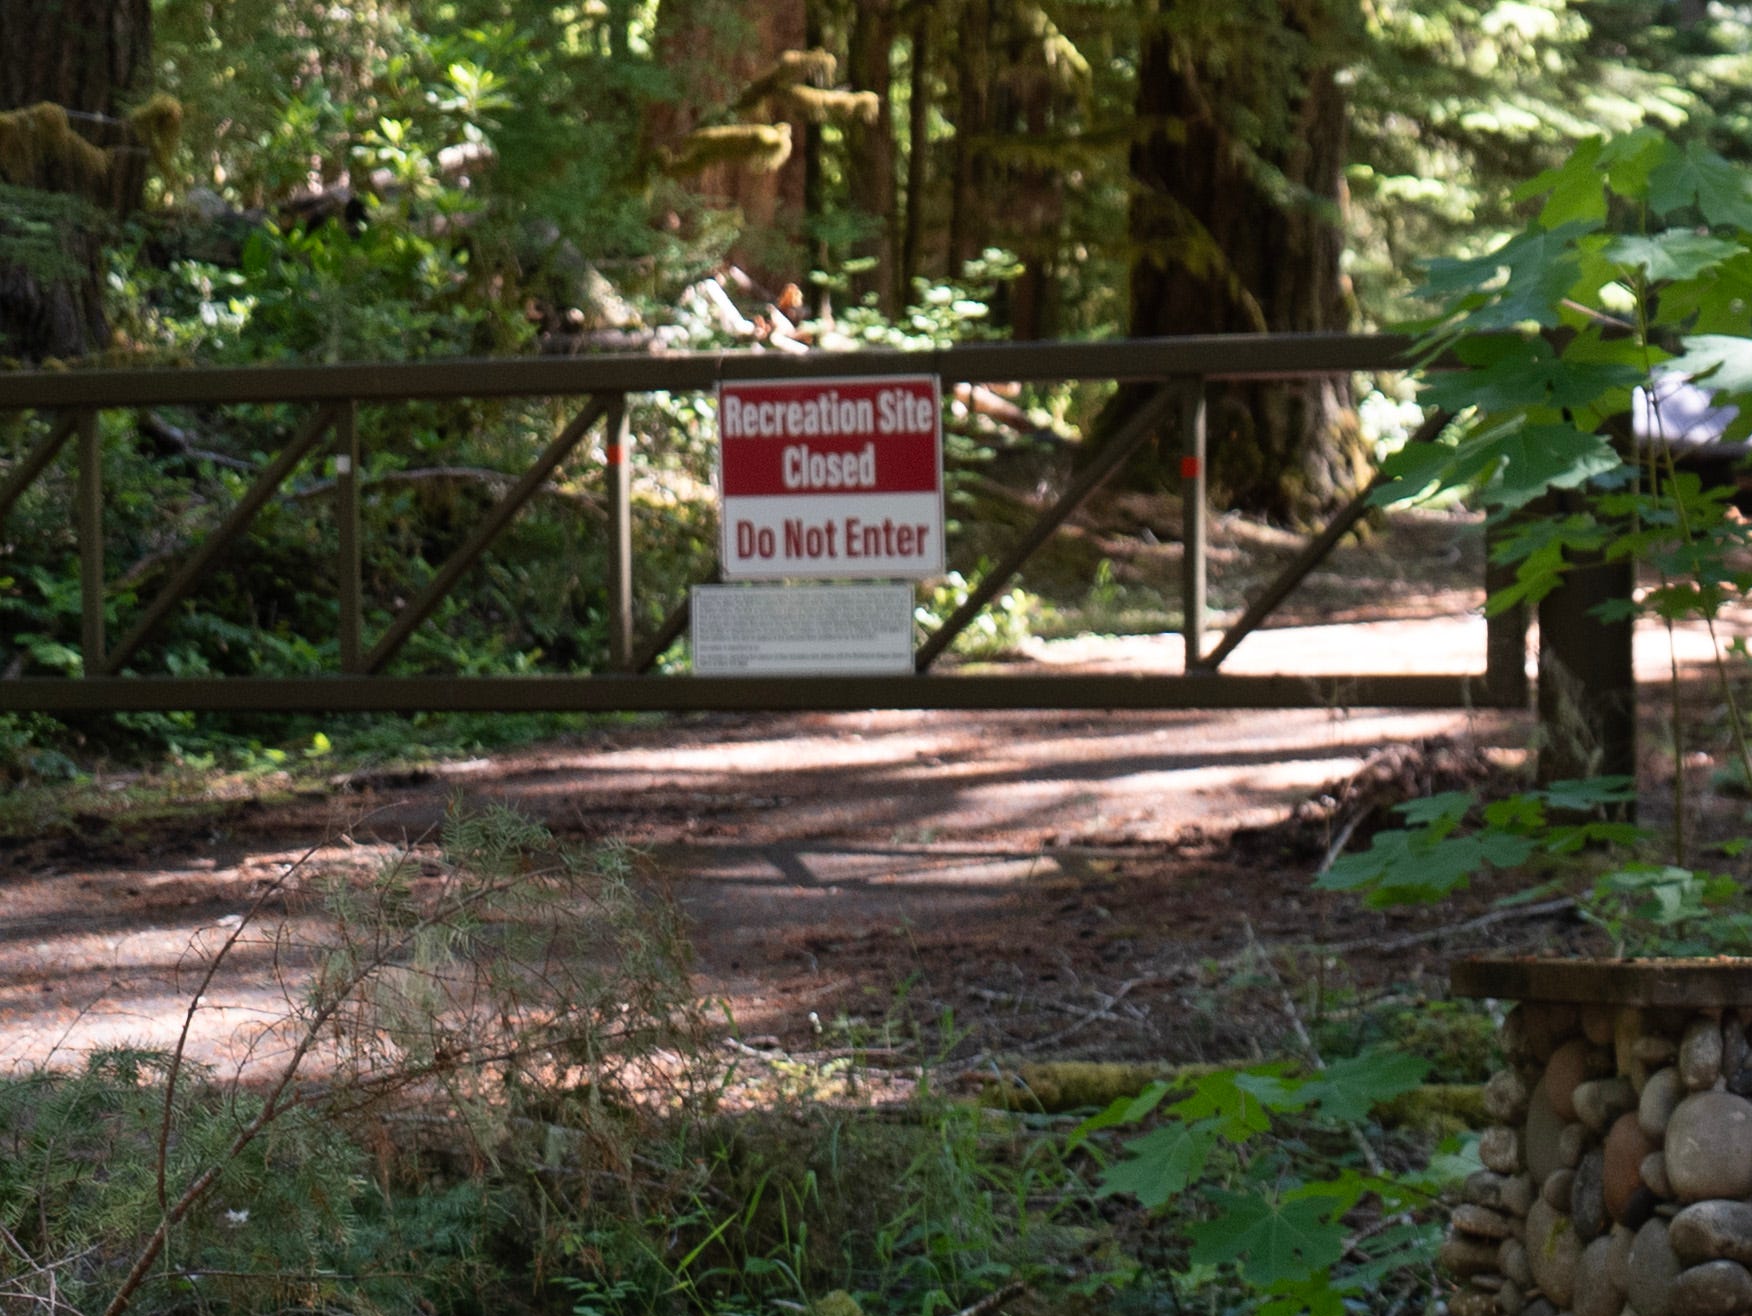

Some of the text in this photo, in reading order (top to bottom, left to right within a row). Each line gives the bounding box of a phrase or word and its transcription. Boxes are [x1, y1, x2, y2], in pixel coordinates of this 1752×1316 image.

[725, 390, 932, 436] Recreation Site
[784, 444, 875, 487] Closed
[736, 516, 930, 560] Do Not Enter
